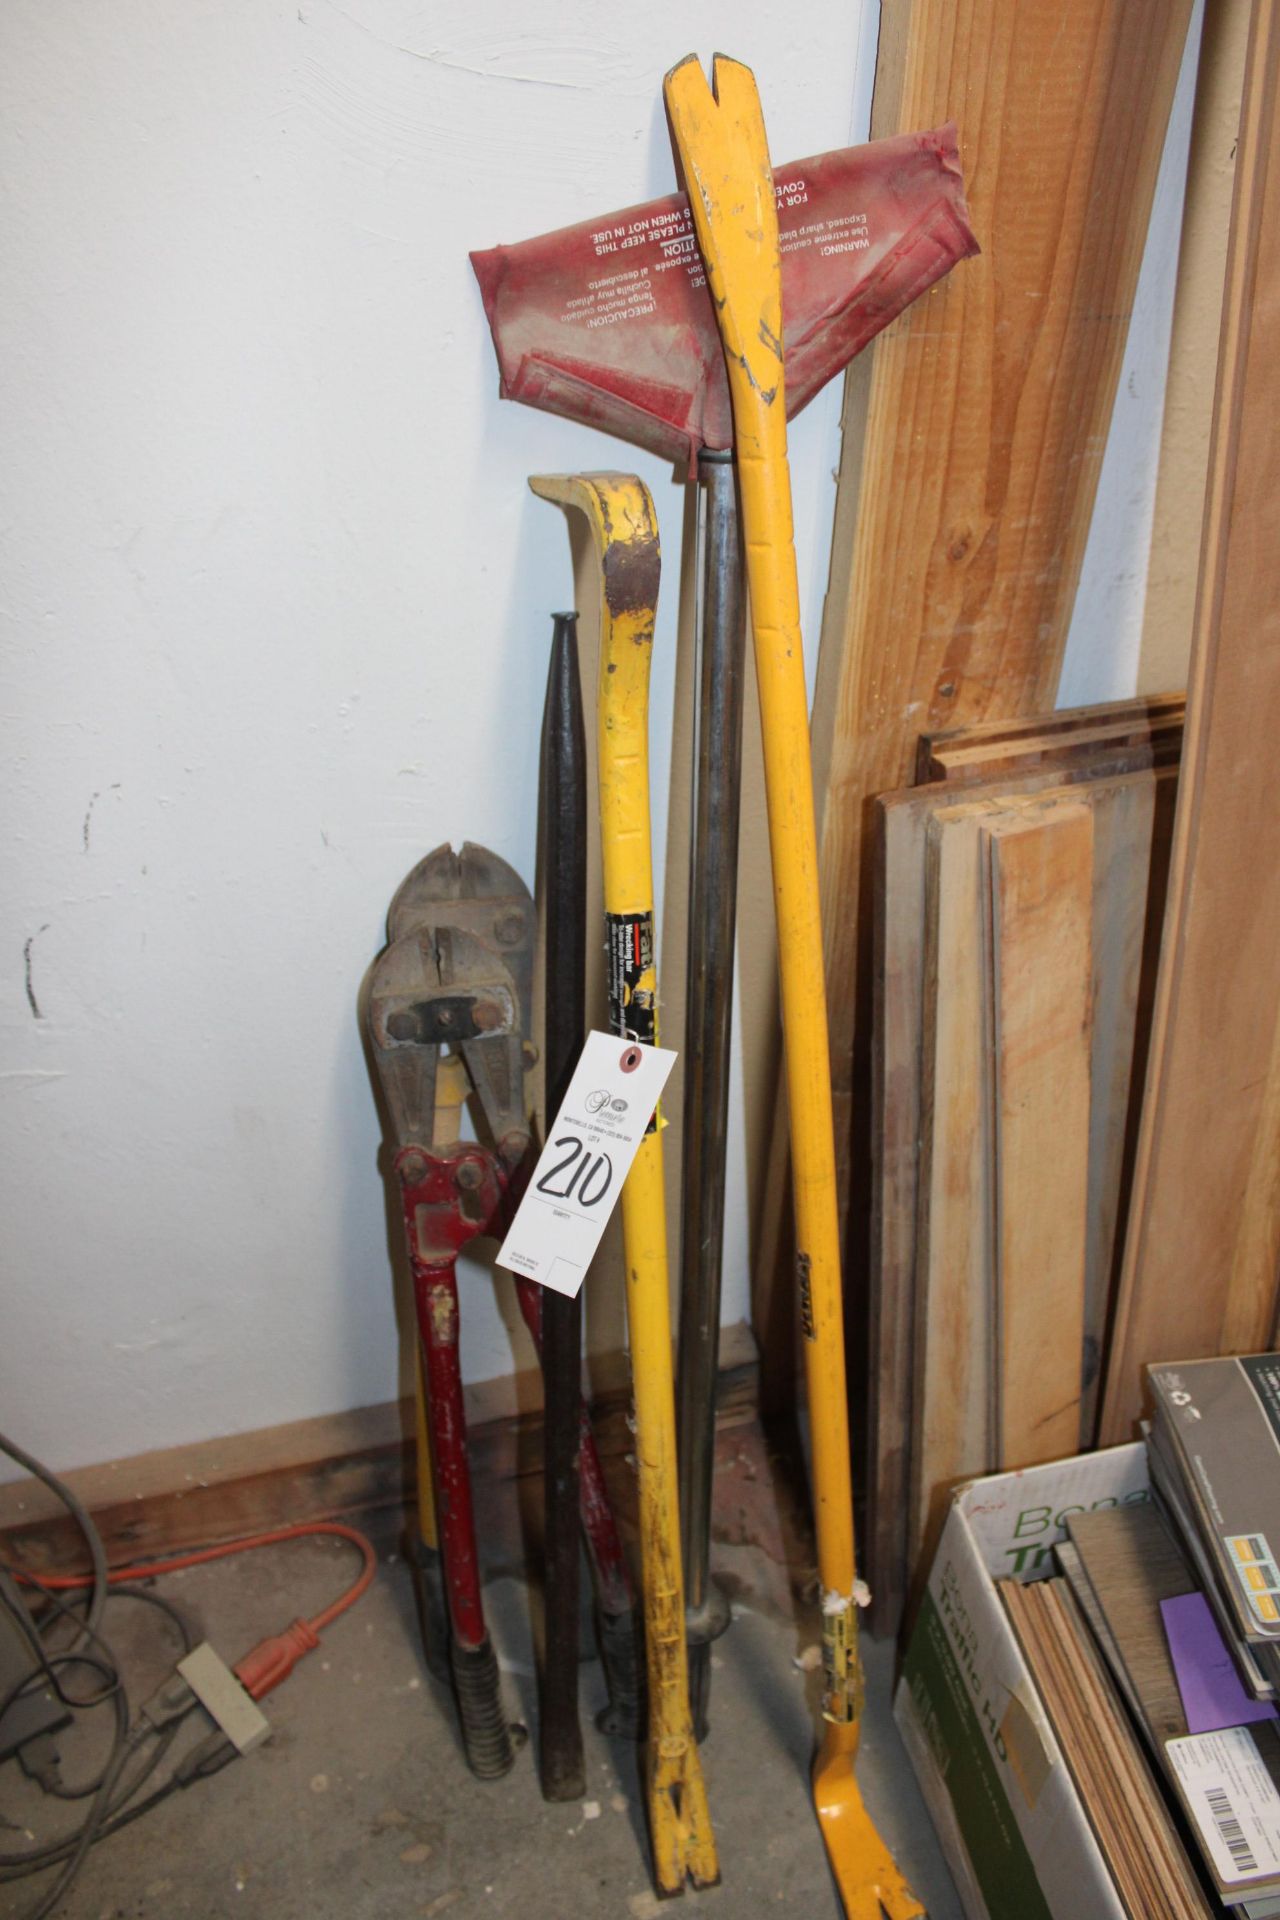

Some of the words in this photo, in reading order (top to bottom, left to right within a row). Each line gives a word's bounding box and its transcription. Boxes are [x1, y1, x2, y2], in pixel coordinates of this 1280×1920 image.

[775, 181, 805, 197] COVE
[787, 192, 808, 206] FOR
[651, 211, 681, 227] WHEN
[614, 229, 626, 237] IN
[628, 221, 649, 232] NOT
[649, 223, 685, 241] PLEASE
[799, 222, 824, 236] sharp
[851, 226, 869, 237] Use
[590, 231, 613, 244] USE.
[621, 235, 646, 249] KEEP
[814, 230, 849, 243] extreme
[595, 244, 618, 256] THIS
[820, 239, 870, 256] WARNING!
[641, 267, 649, 276] al
[597, 288, 615, 300] muy
[616, 280, 651, 295] Cuchilla
[628, 291, 655, 303] Tenga
[597, 299, 626, 312] mucho
[624, 924, 634, 961] Wrecking
[625, 960, 634, 972] bar
[536, 1136, 612, 1208] 210
[1004, 1543, 1050, 1573] Tr
[983, 1699, 1008, 1763] HD
